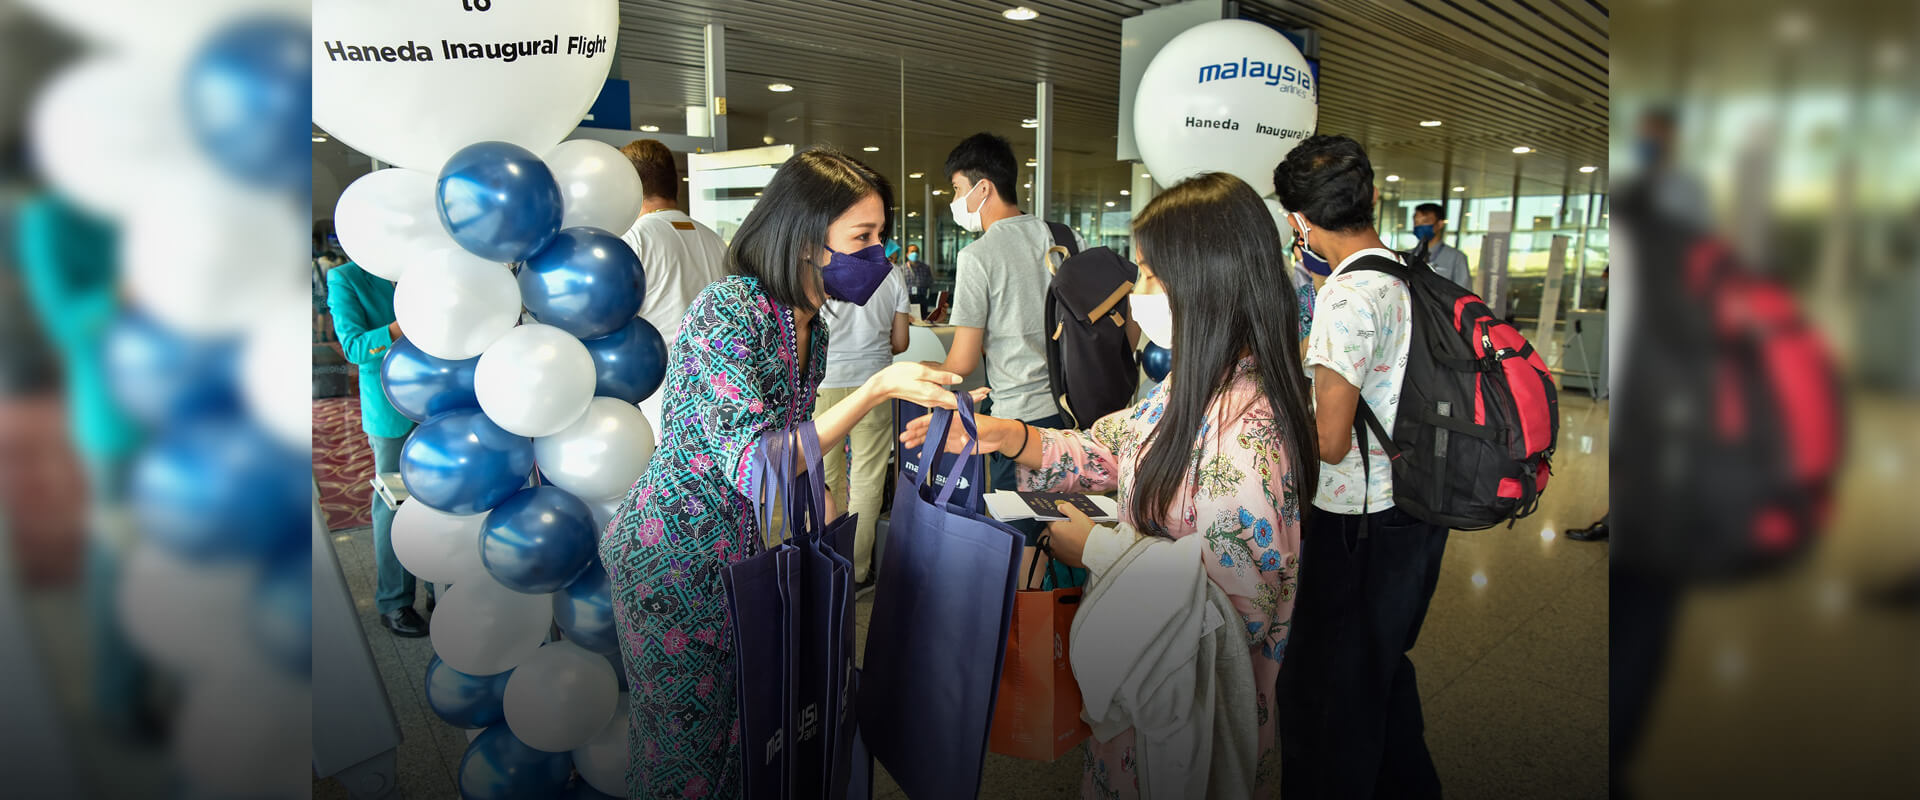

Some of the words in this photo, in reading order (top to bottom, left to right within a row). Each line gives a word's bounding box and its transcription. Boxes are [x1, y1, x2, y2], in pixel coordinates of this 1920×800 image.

[324, 40, 434, 62] Haneda
[441, 35, 559, 62] Inaugural
[567, 35, 607, 58] Flight
[1198, 57, 1311, 90] malaysia
[1185, 117, 1240, 131] Haneda
[1256, 123, 1304, 140] Inaugural
